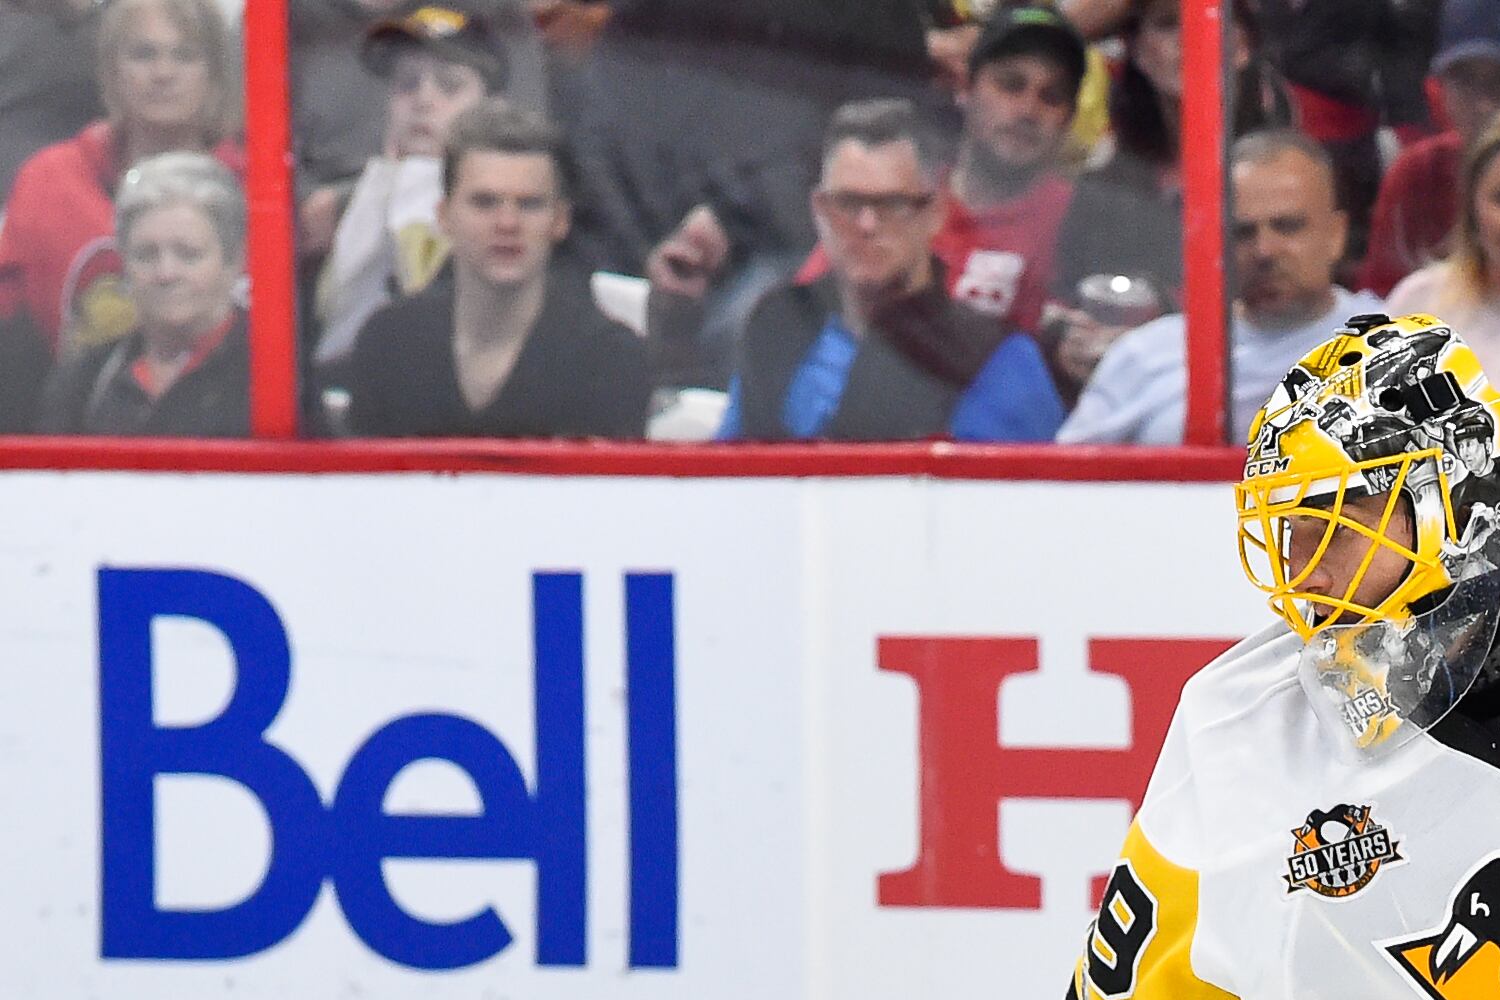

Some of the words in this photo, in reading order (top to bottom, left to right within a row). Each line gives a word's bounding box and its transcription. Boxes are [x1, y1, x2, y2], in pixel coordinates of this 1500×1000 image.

[1246, 458, 1291, 478] CCM
[96, 565, 681, 973] Bell
[1290, 853, 1320, 881] 50
[1321, 832, 1388, 870] YEARS
